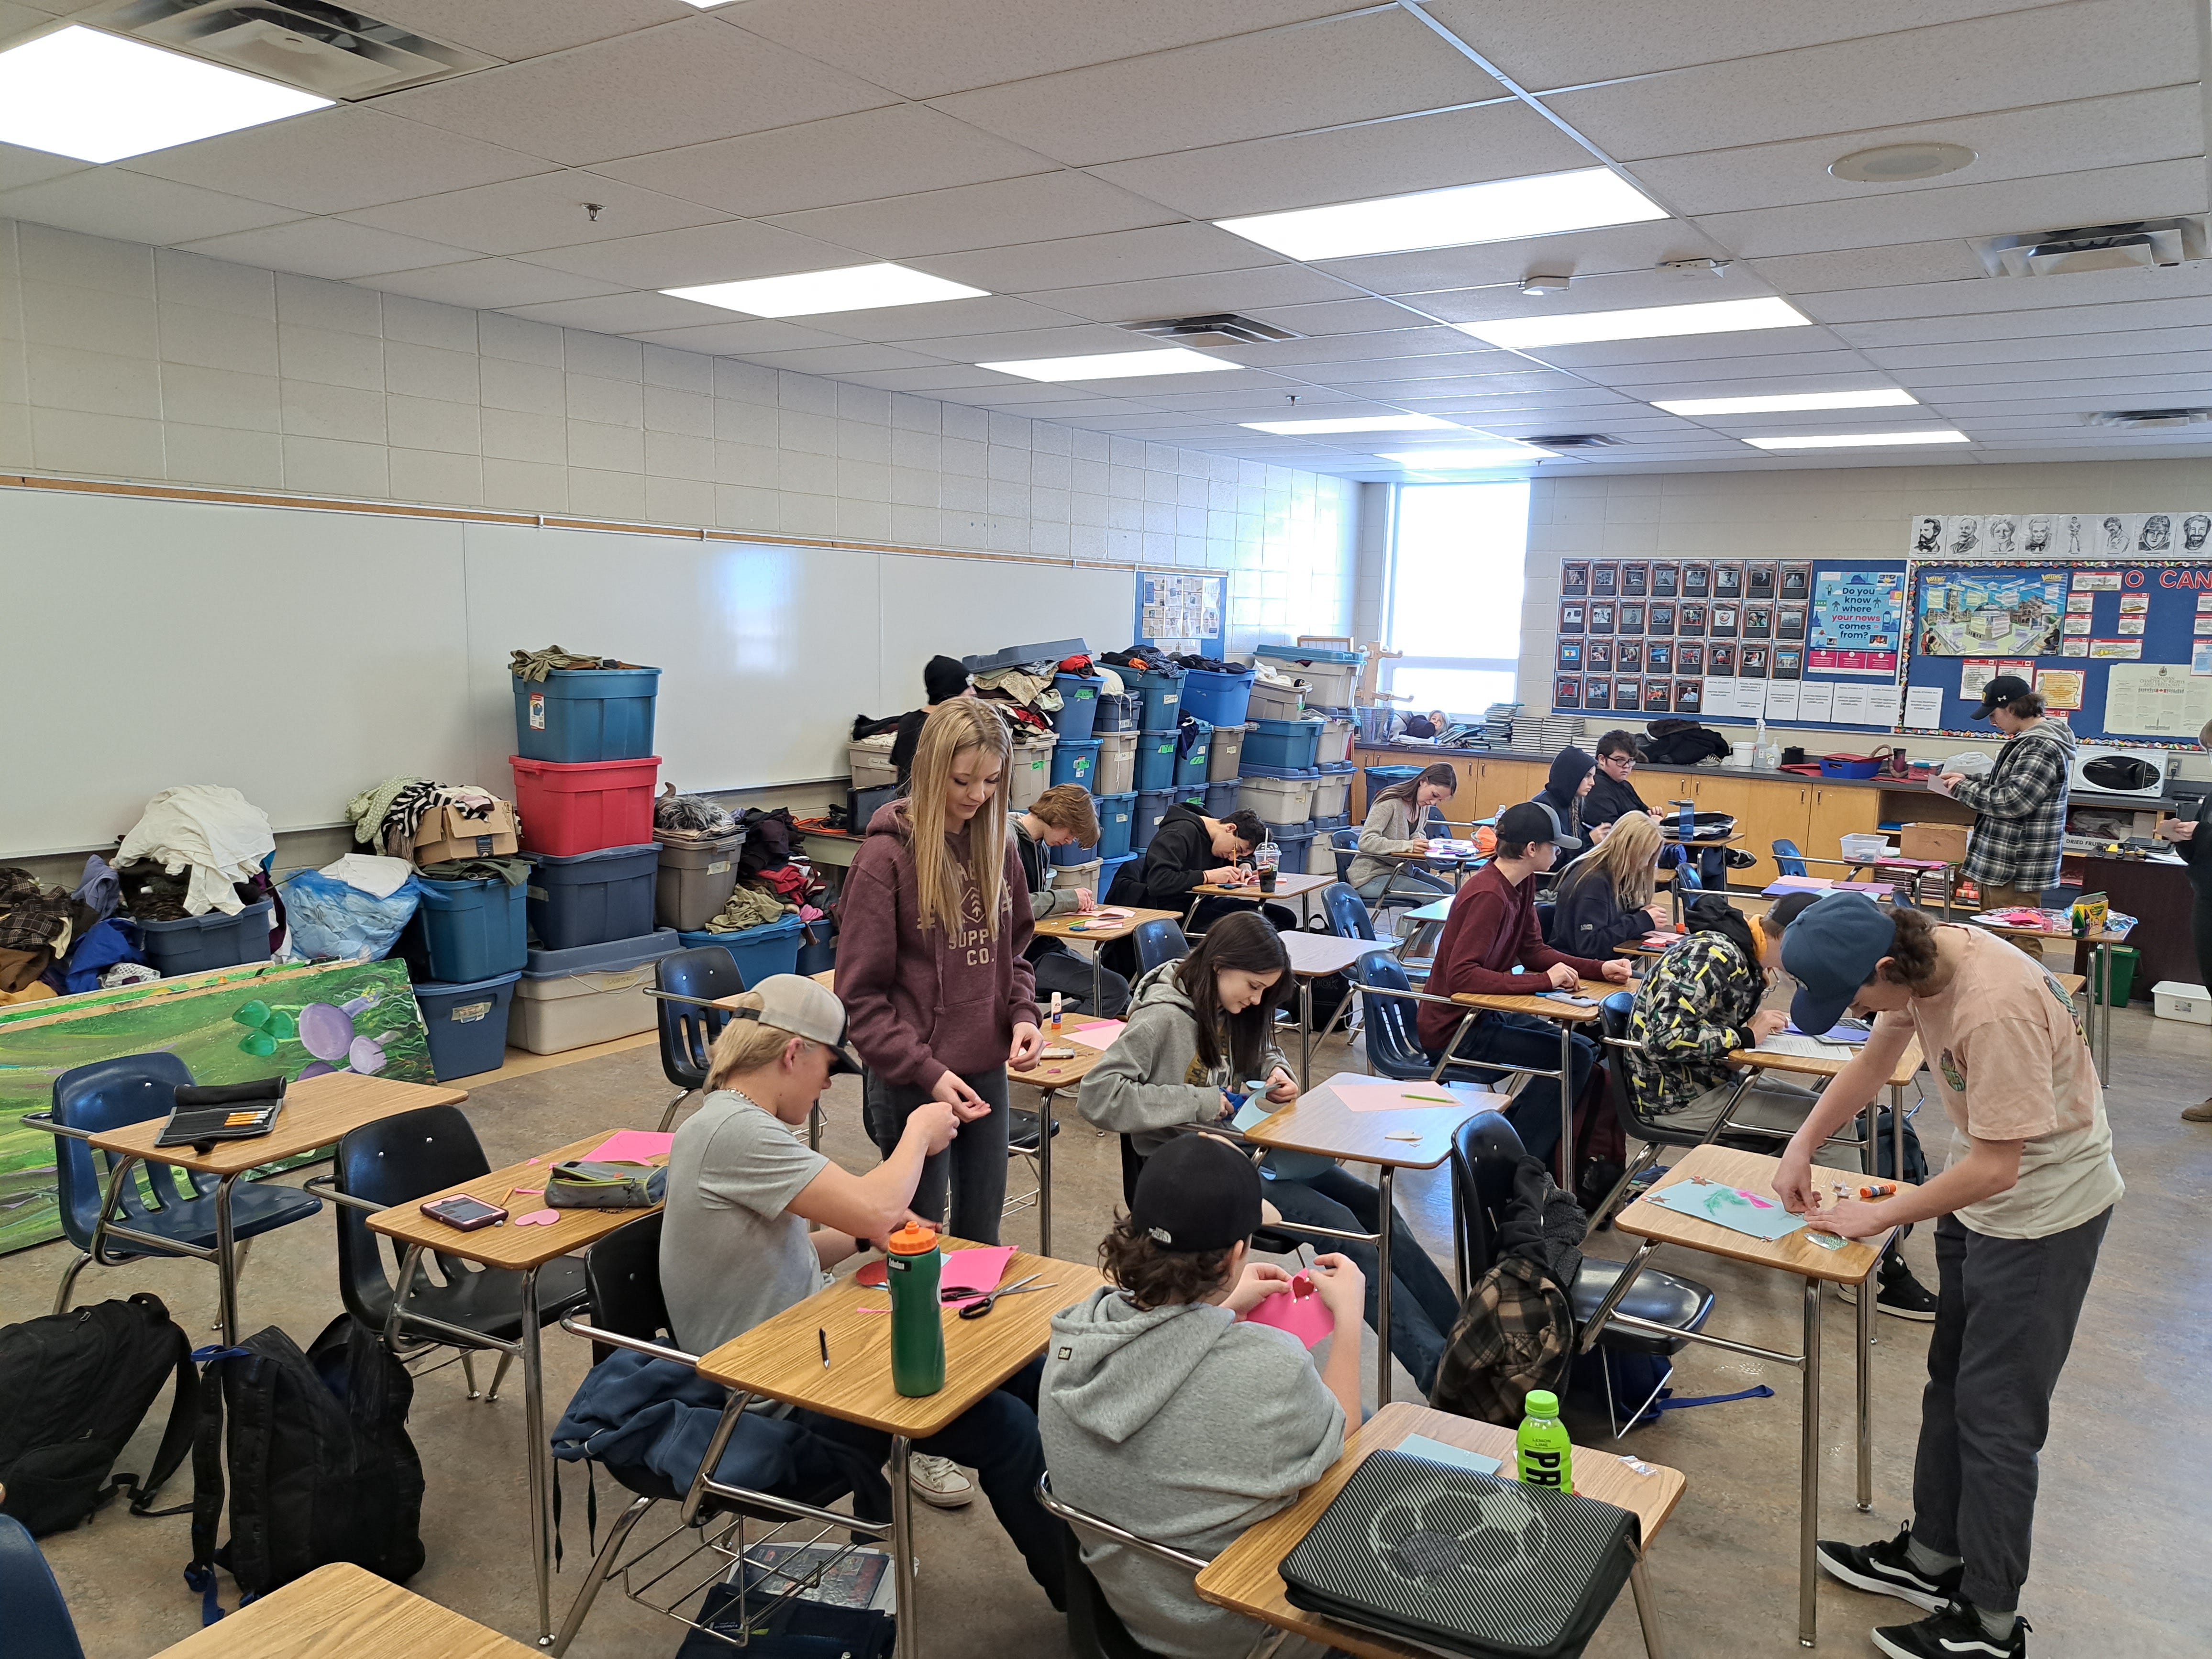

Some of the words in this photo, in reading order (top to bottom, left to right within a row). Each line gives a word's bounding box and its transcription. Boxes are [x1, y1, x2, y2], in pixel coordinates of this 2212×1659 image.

[2124, 570, 2145, 588] O
[2159, 570, 2212, 589] CAN
[1832, 614, 1854, 622] your
[949, 929, 990, 950] SUPP
[966, 948, 995, 965] CO.
[1525, 1449, 1561, 1492] PR
